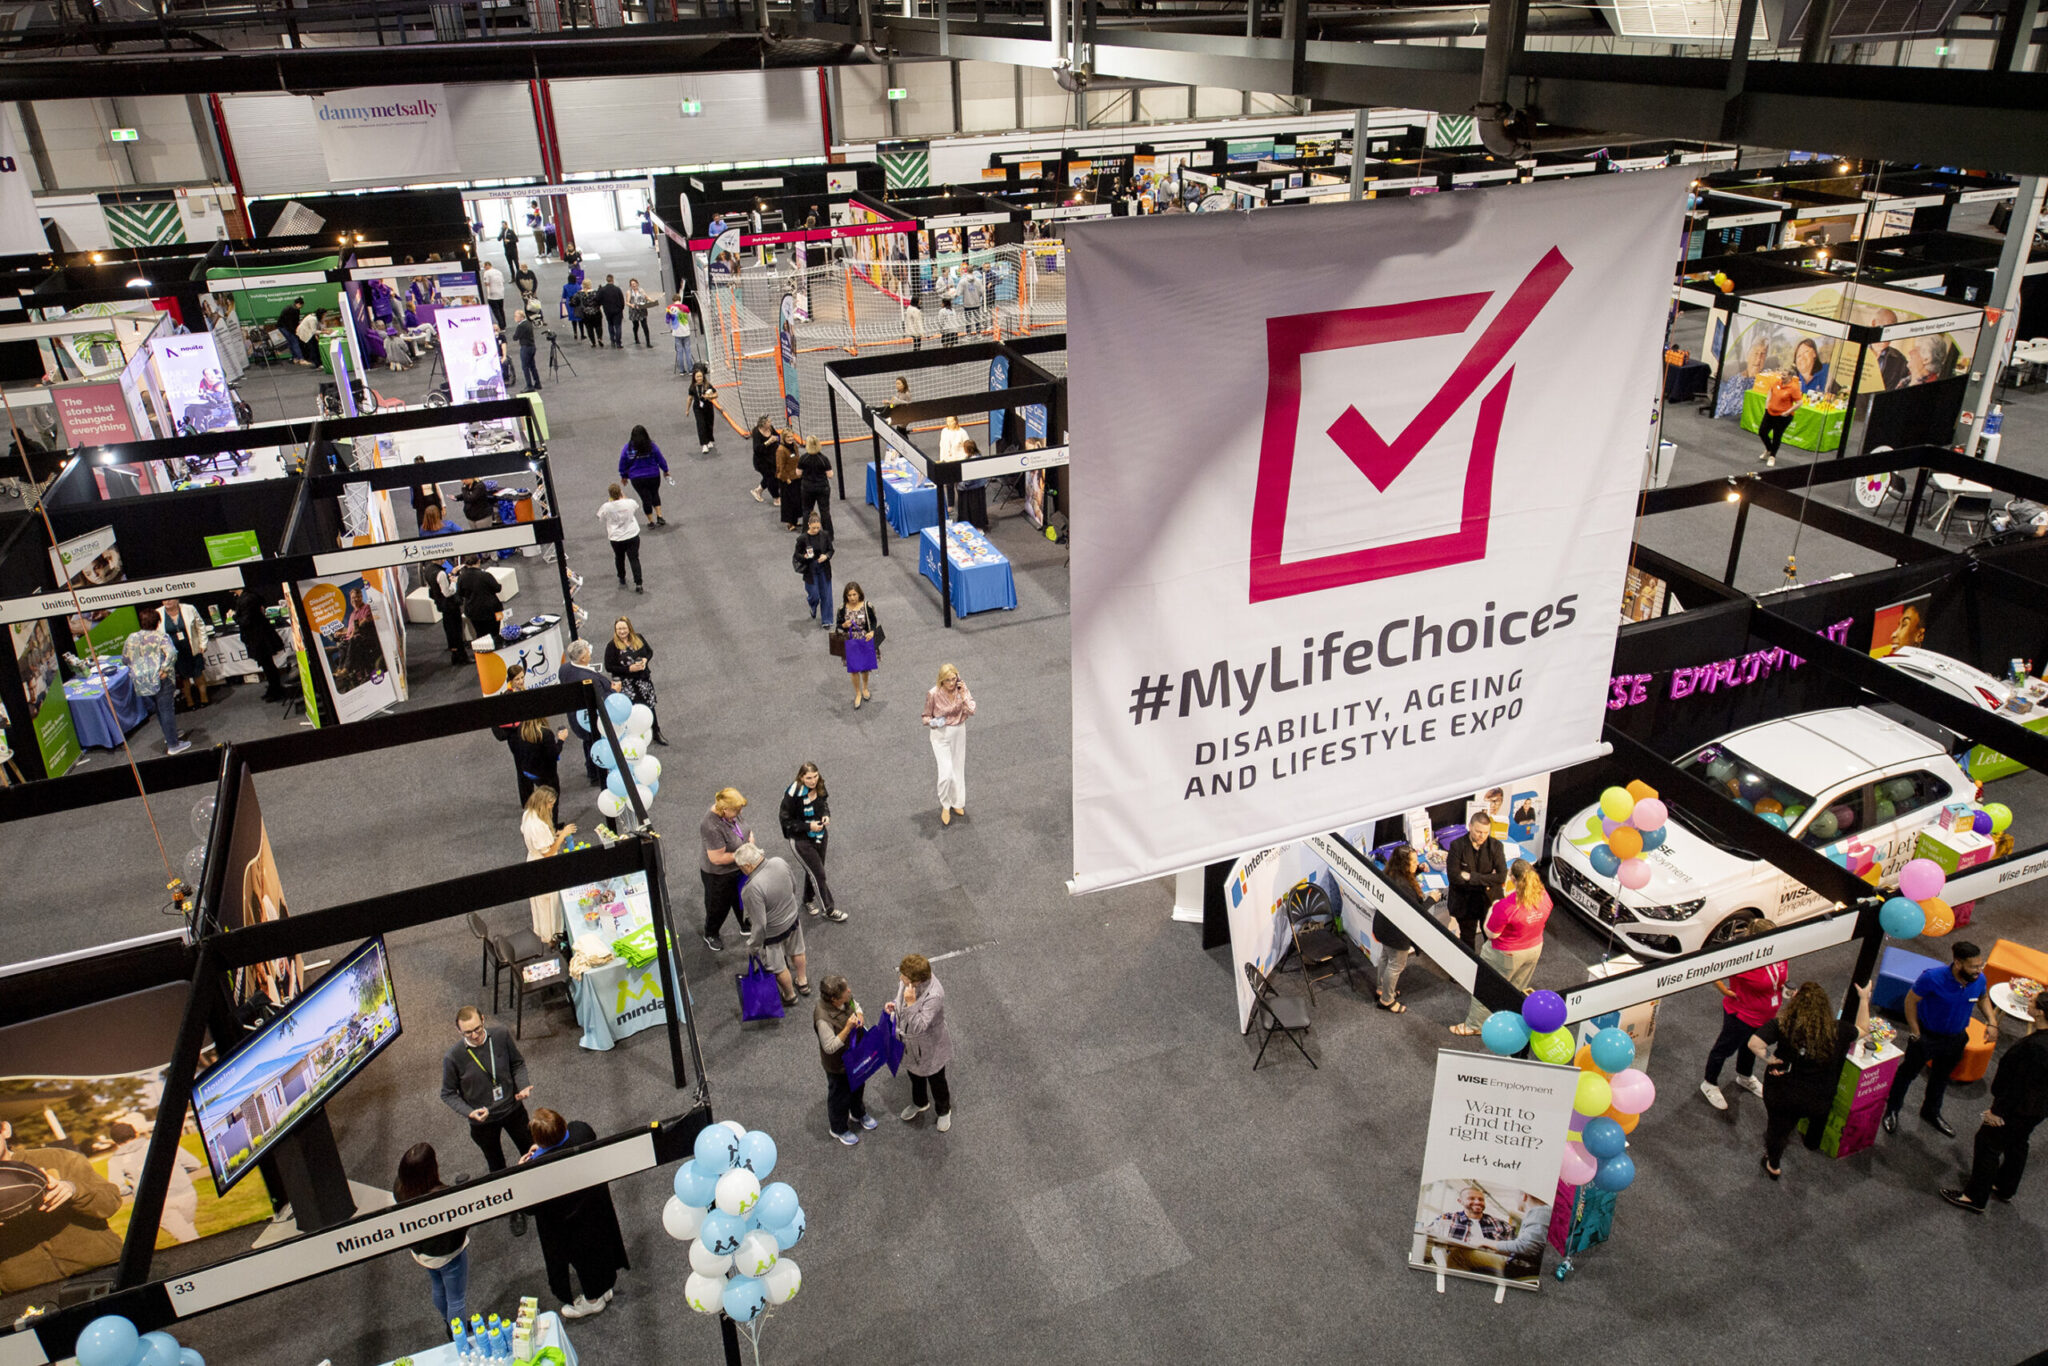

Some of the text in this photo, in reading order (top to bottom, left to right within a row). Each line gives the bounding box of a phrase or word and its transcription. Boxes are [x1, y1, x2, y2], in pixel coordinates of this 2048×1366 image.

[1091, 158, 1126, 167] MMUNITY
[1767, 310, 1783, 320] Helping
[1796, 318, 1806, 326] Aged
[61, 398, 83, 406] The
[66, 404, 116, 416] store that
[68, 413, 114, 426] changed
[72, 422, 126, 436] everything
[72, 540, 99, 555] UNITING
[421, 542, 453, 552] ENHANCED
[422, 546, 454, 557] Lifestyles
[42, 580, 196, 611] Uniting Communities Law Centre
[1130, 594, 1578, 724] #MyLifeChoices
[1195, 669, 1523, 766] DISABILITY, AGEING
[1184, 697, 1523, 800] AND LIFESTYLE EXPO
[1658, 844, 1676, 857] SE
[1312, 836, 1385, 904] ise Employment Ltd
[1994, 870, 2016, 884] Wise
[1570, 944, 1774, 1006] 10 Wise Employment Ltd
[616, 998, 666, 1026] minda
[204, 1066, 236, 1096] Housing
[1860, 1076, 1880, 1088] staff?
[1862, 1068, 1880, 1080] Need
[1457, 1074, 1554, 1096] WISE Employment
[1858, 1086, 1873, 1098] Let's
[1466, 1099, 1536, 1121] Want to
[1464, 1114, 1532, 1134] find the
[1449, 1127, 1543, 1150] right staff?
[1463, 1154, 1522, 1171] Let's chat!
[174, 1188, 514, 1296] 33 Minda Incorporated
